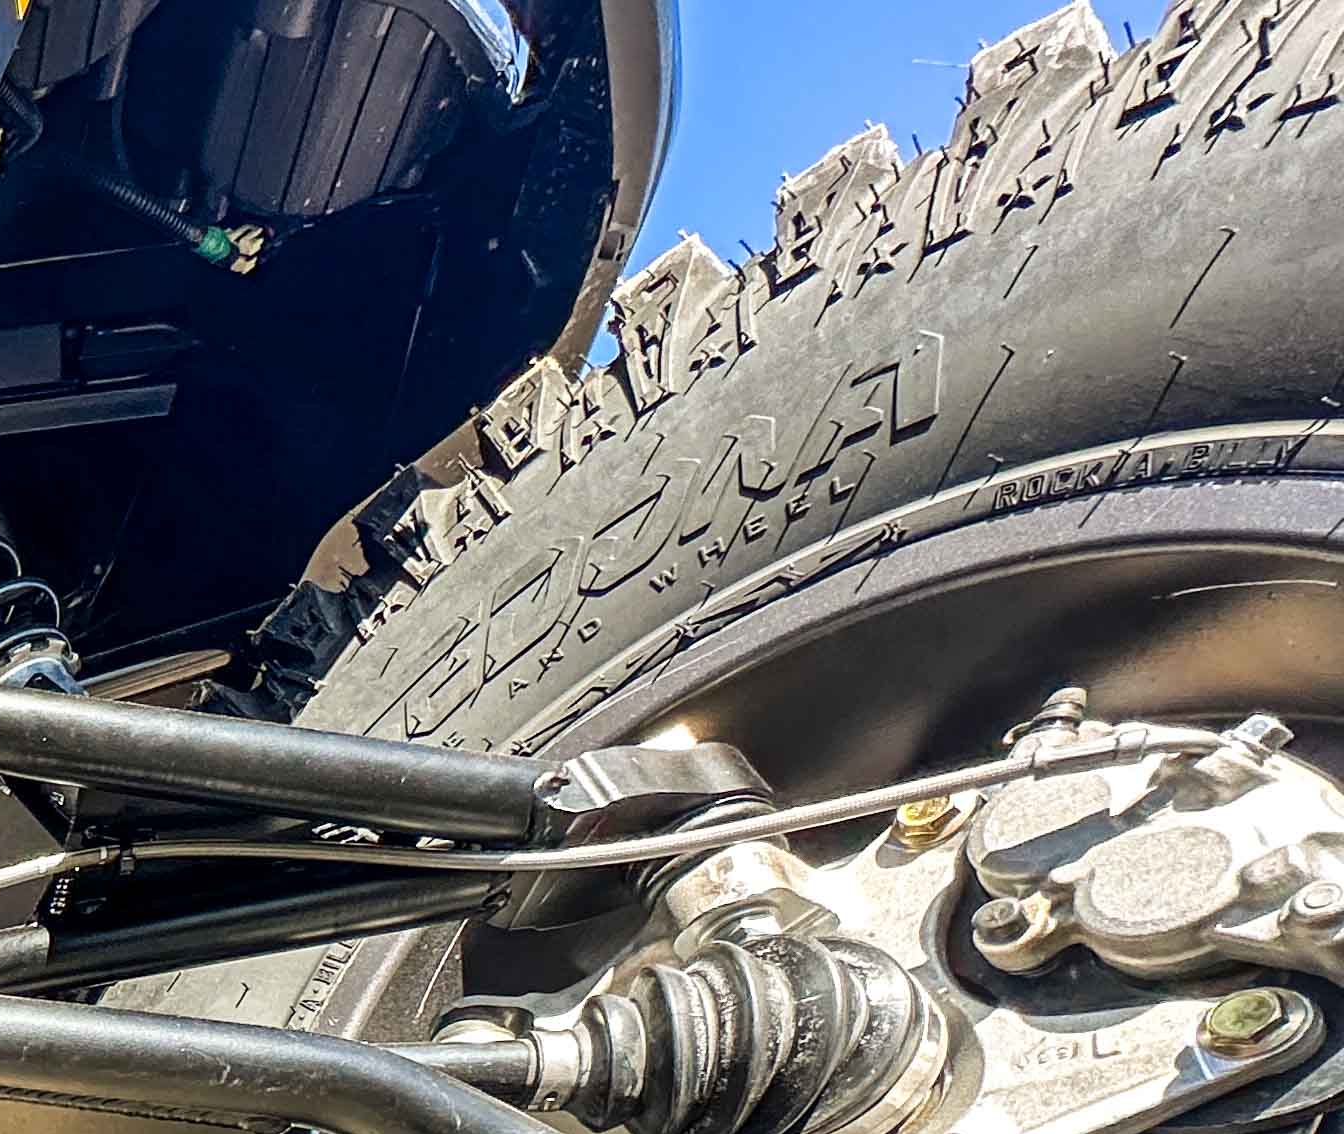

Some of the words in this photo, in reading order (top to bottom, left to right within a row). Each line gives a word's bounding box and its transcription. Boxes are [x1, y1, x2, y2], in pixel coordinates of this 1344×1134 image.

[364, 330, 944, 742] EDONA
[648, 481, 857, 596] WHEEL
[993, 461, 1102, 511] ROCK
